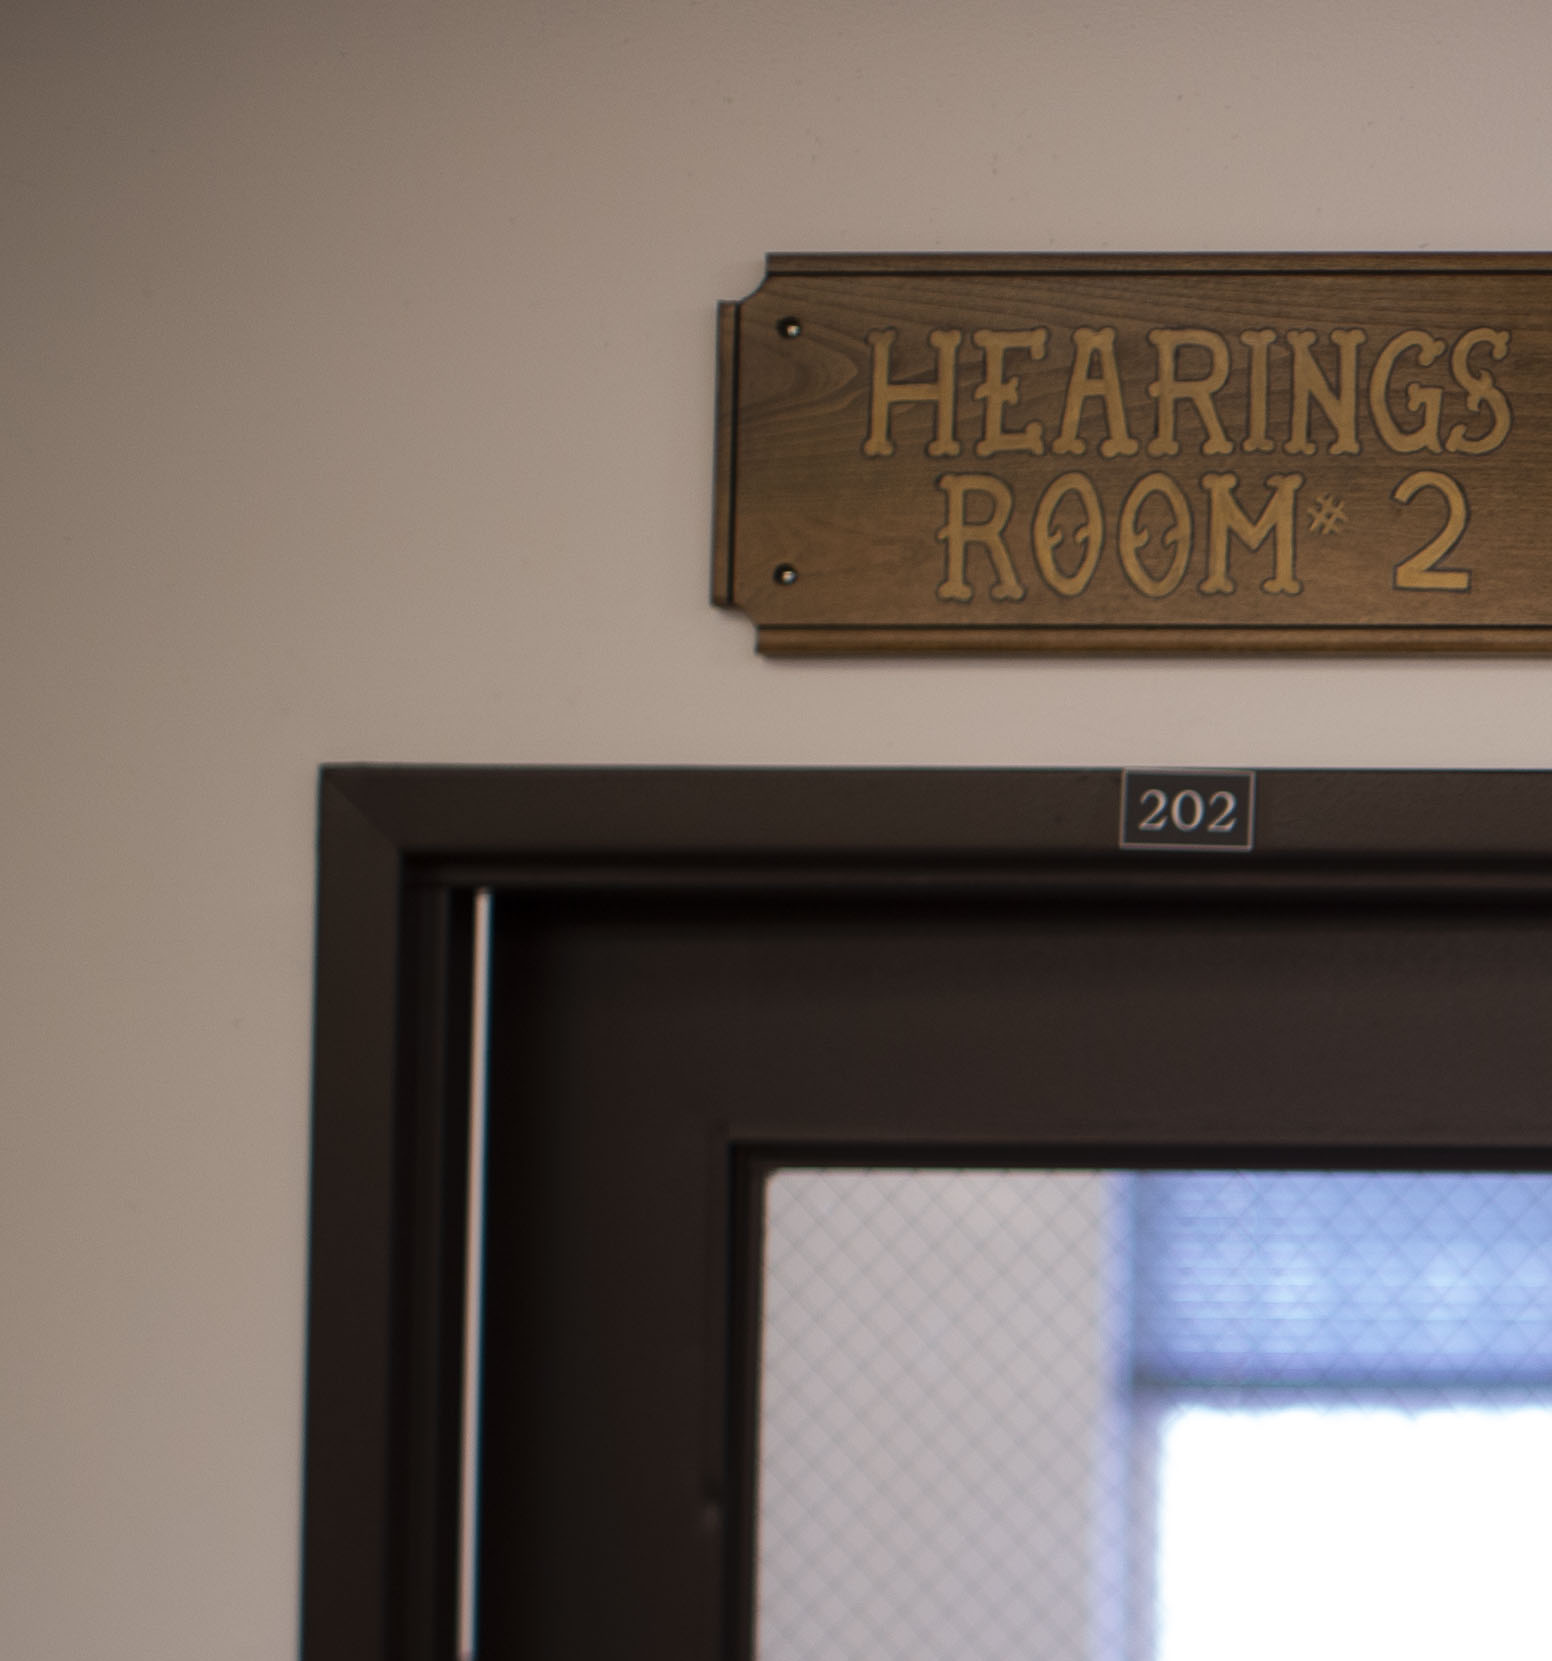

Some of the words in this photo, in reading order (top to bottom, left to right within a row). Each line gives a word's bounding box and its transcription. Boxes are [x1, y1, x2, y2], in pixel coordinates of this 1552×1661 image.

[863, 326, 1512, 457] HEARINGS
[1391, 470, 1471, 592] 2
[1137, 788, 1238, 834] 202
